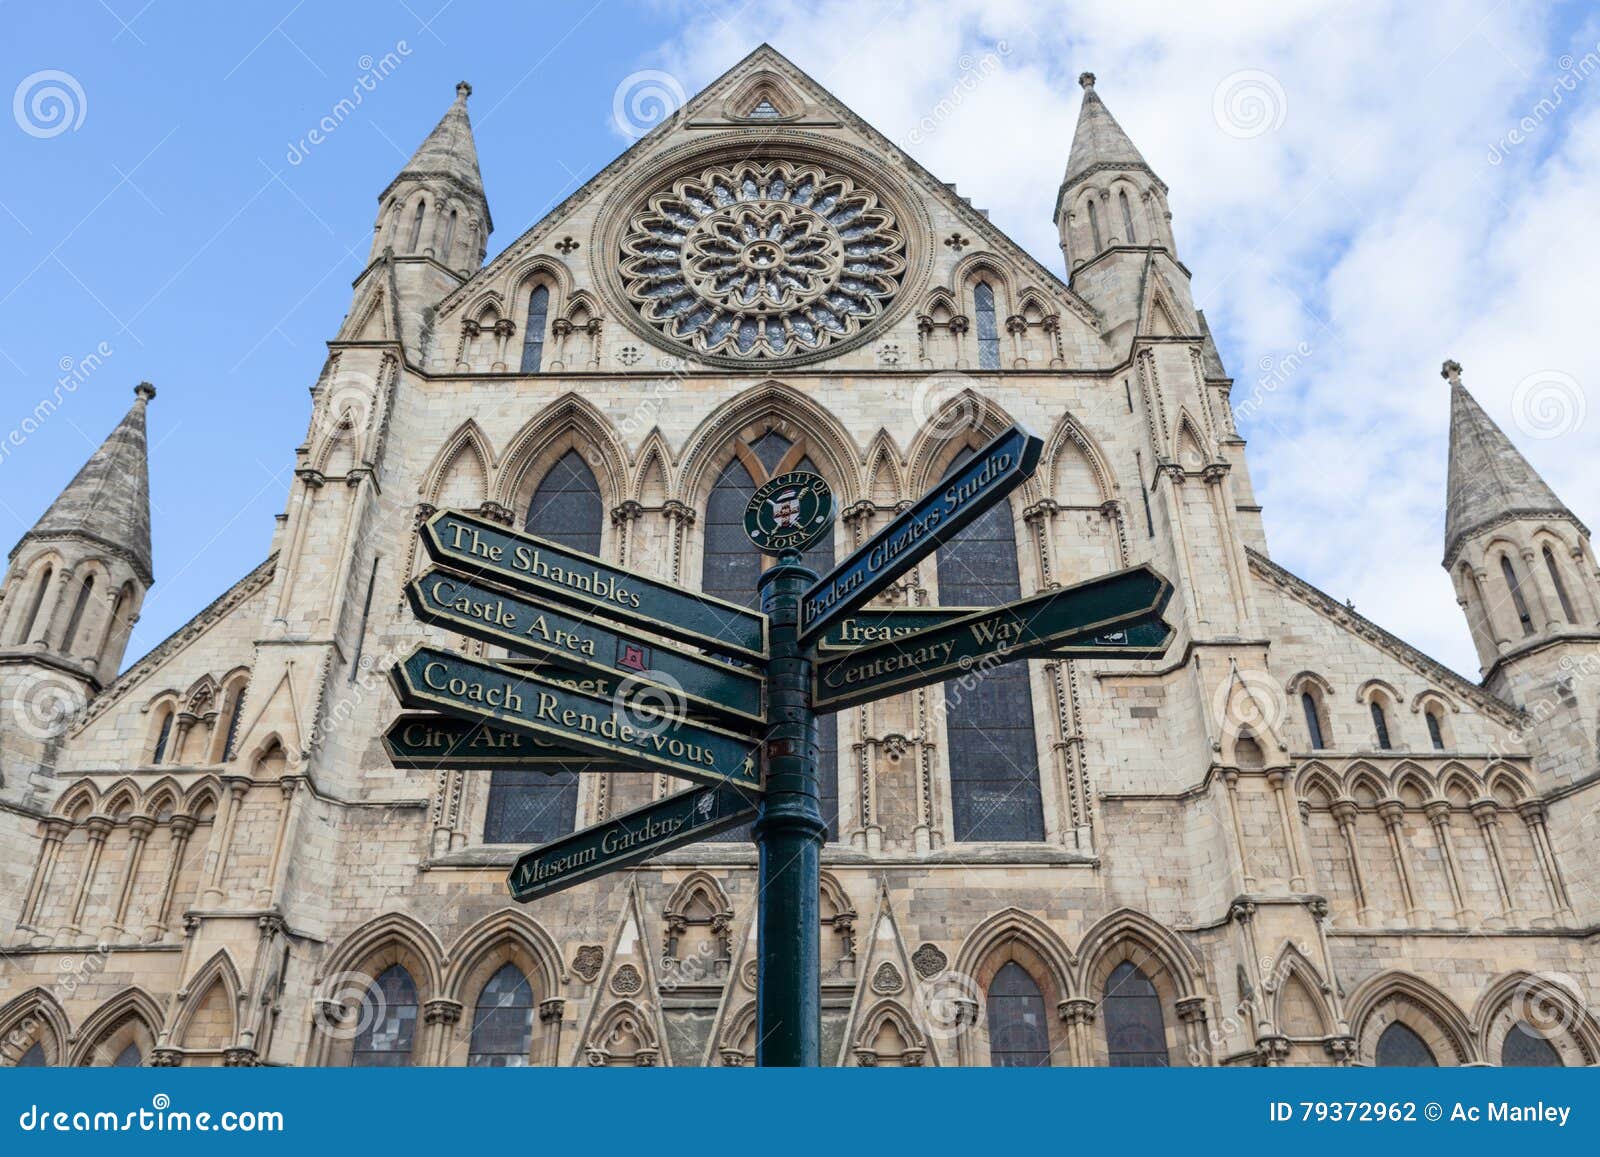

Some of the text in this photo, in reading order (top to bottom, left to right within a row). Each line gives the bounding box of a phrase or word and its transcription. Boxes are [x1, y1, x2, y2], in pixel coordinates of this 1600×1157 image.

[747, 473, 832, 512] THE CITY OF
[447, 522, 640, 609] The Shambles
[765, 531, 811, 548] YORK
[805, 452, 1012, 624] Bedern Glaziers Studio
[431, 579, 596, 657] Castle Area
[824, 616, 1028, 689] Centenary Way
[403, 723, 461, 753] City
[470, 725, 523, 748] Art
[423, 662, 715, 767] Coach Rendezvous
[519, 814, 684, 887] Museum Gardens
